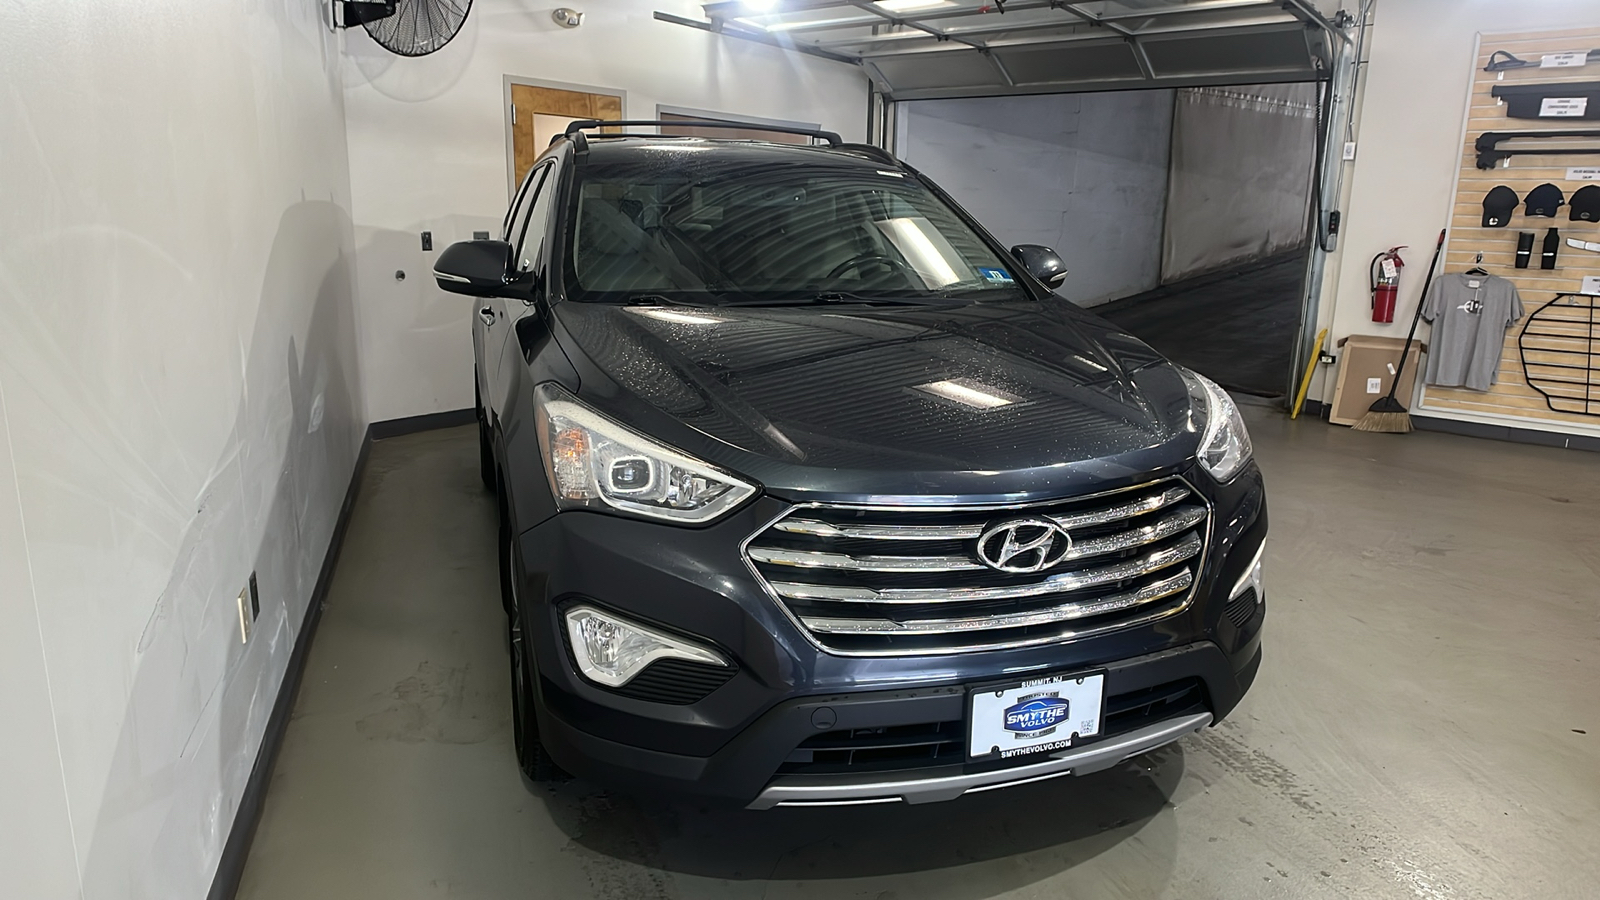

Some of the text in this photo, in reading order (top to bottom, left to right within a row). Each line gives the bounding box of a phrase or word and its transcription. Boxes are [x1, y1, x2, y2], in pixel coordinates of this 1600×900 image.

[1007, 708, 1065, 724] SMYTHE
[1020, 716, 1055, 728] VOLVO
[1001, 740, 1071, 759] SMYTHEVOLVO.COM
